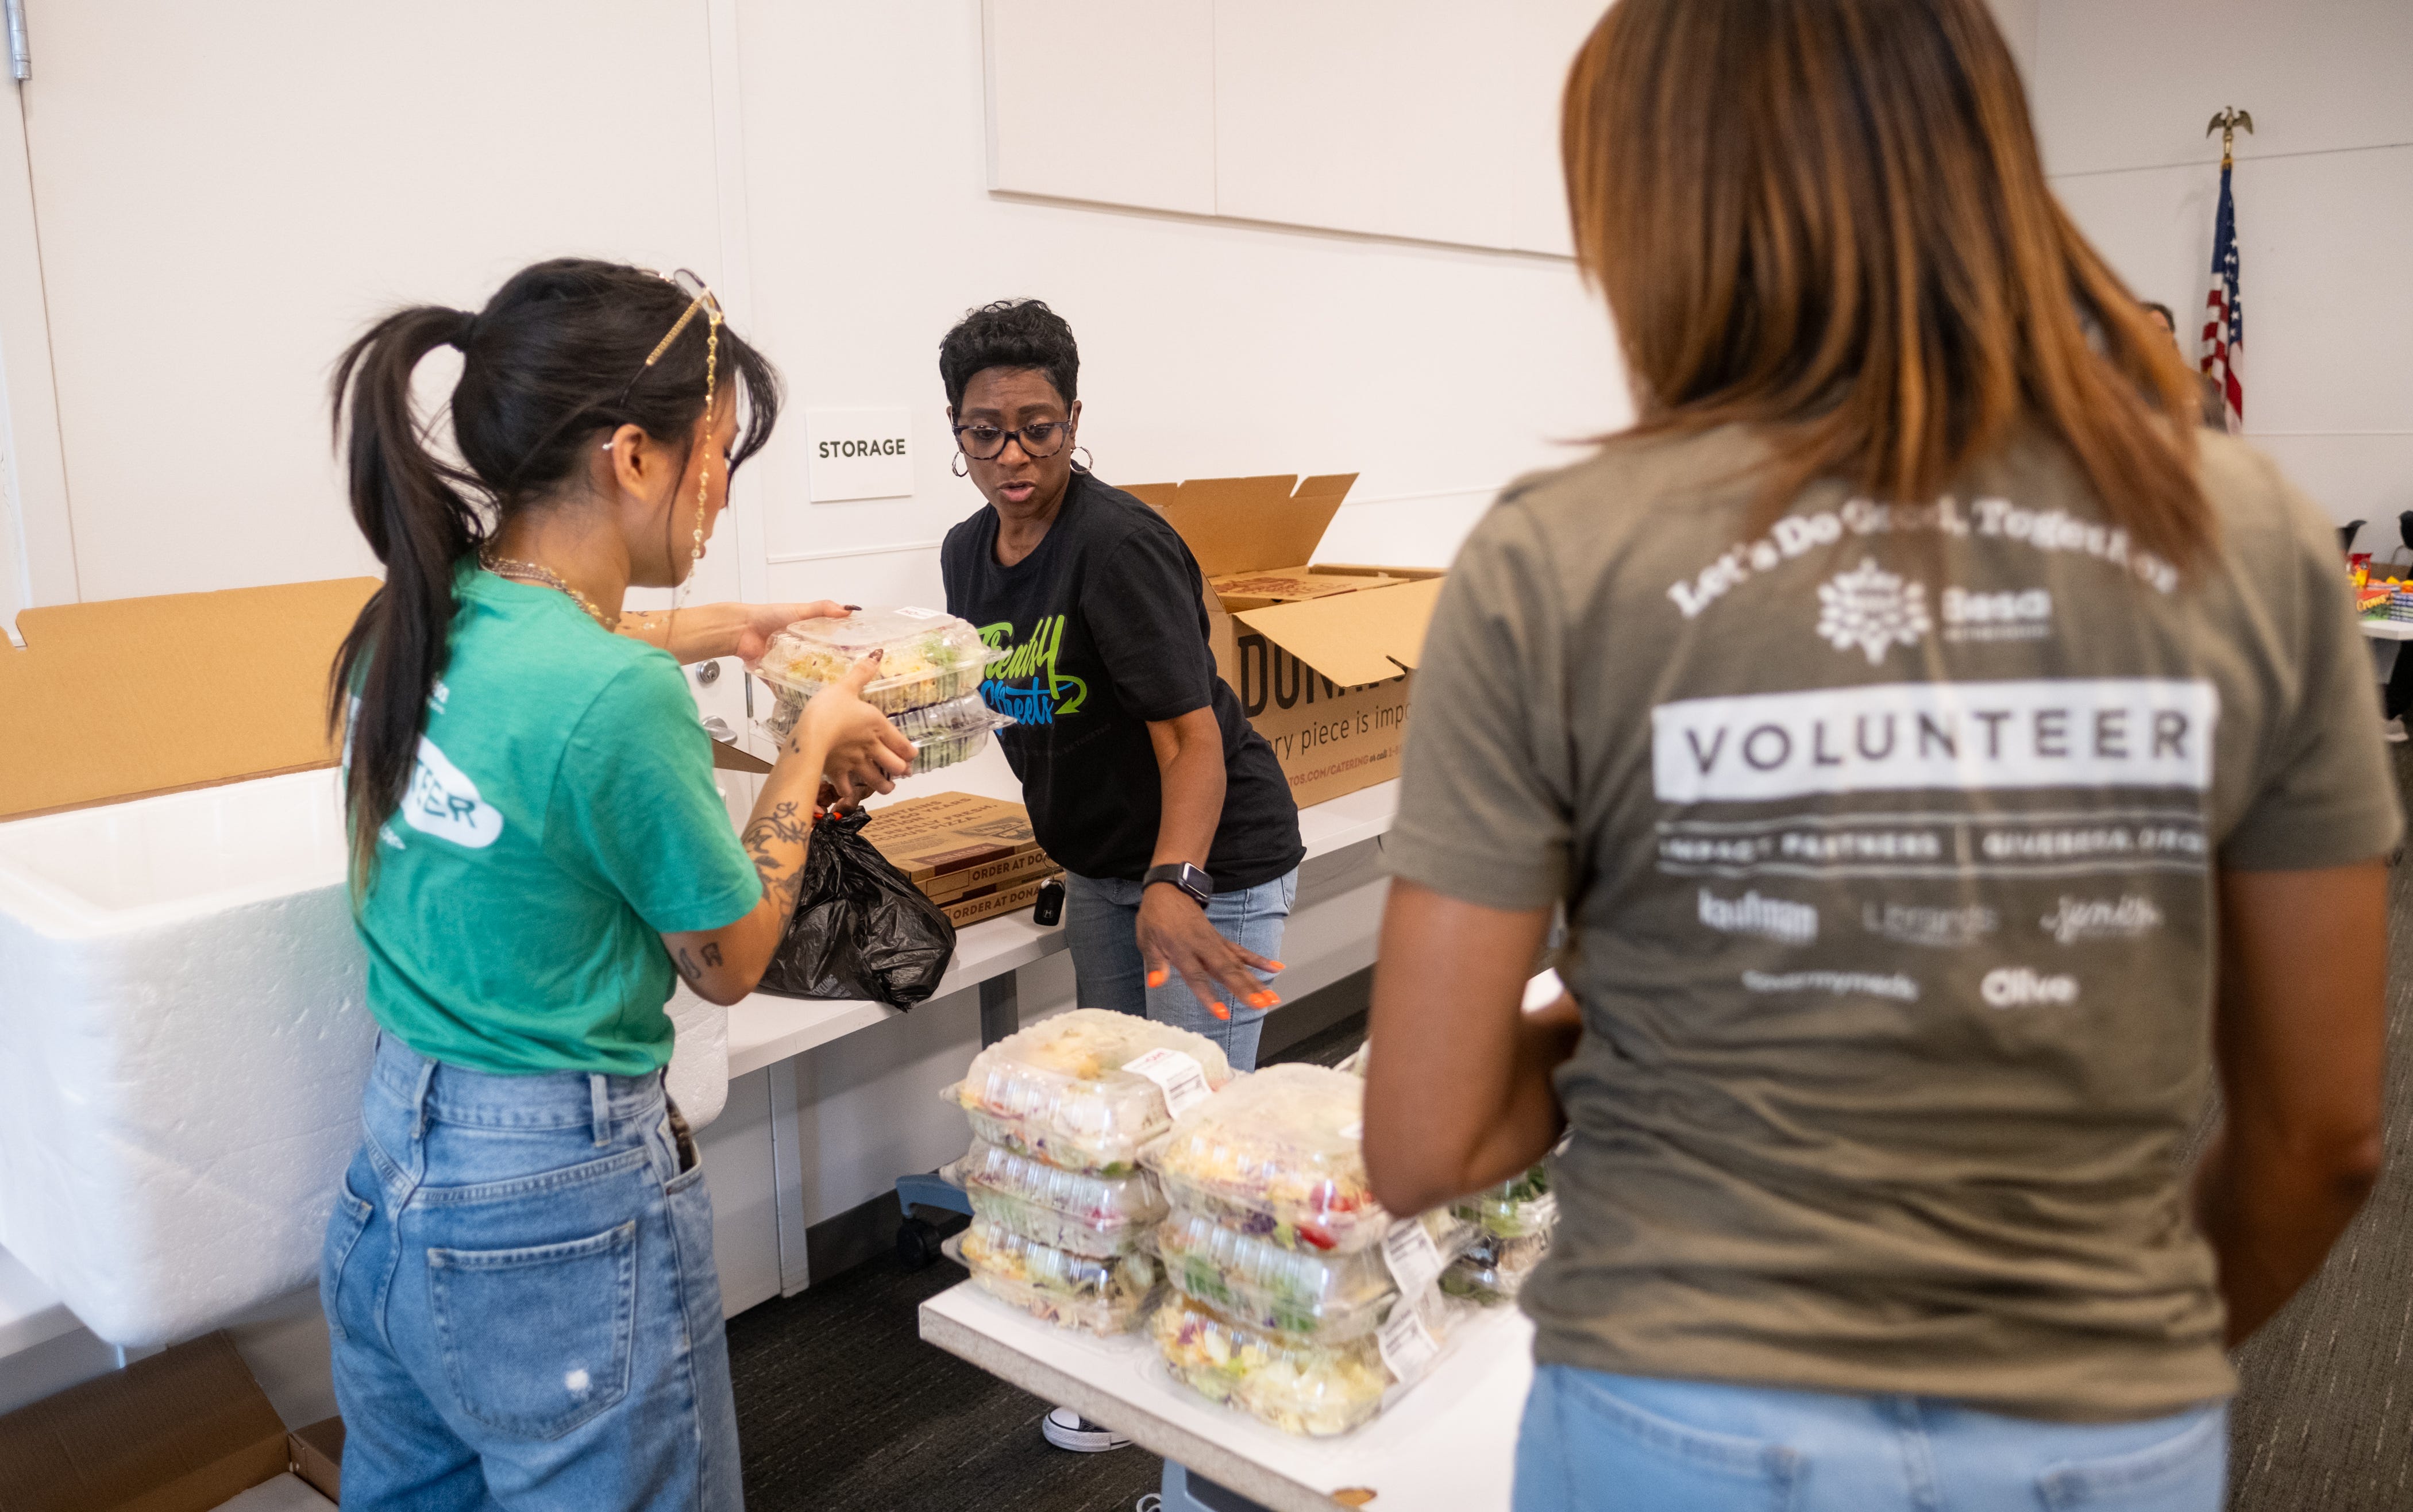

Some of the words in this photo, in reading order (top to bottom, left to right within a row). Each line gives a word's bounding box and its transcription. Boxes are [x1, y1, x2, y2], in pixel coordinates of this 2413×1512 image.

[819, 438, 906, 458] STORAGE
[1772, 512, 1841, 557] Do
[1841, 496, 1969, 536] Gd
[1301, 719, 1349, 755] piece
[1356, 711, 1369, 734] is
[1685, 709, 2190, 774] VOLUNTEER
[1288, 754, 1369, 788] TOS.COM/CATERING
[1781, 832, 1941, 858] PARTNERS
[972, 862, 1010, 881] ORDER
[1012, 858, 1025, 871] AT
[1028, 853, 1050, 866] DO
[953, 901, 992, 920] ORDER
[993, 896, 1008, 908] AT
[1981, 967, 2079, 1007] Olive
